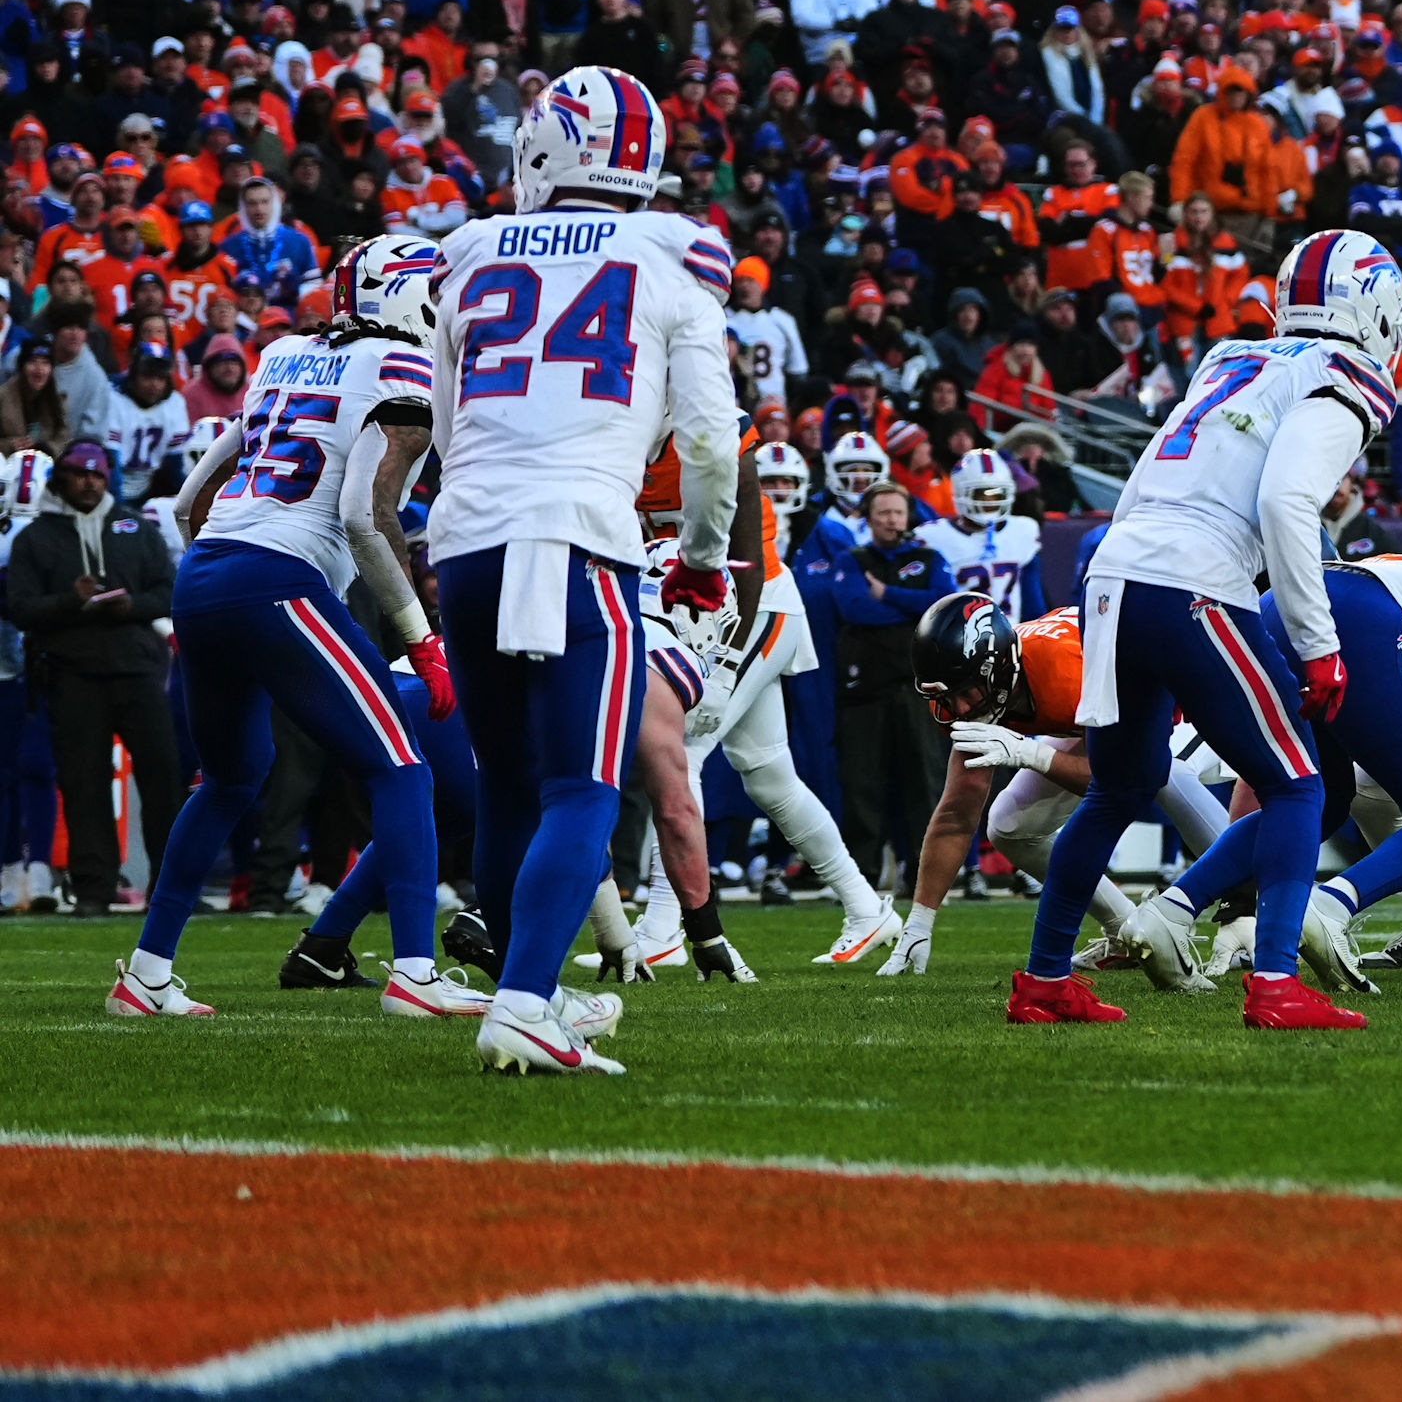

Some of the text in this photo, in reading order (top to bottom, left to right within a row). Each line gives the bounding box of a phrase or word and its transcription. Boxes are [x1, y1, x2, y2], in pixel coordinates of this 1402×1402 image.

[589, 174, 654, 191] CHOOSE LOVE
[498, 222, 616, 257] BISHOP
[459, 262, 638, 407] 24
[258, 354, 351, 387] THOMPSON
[1155, 354, 1270, 460] 7
[128, 426, 165, 470] 17
